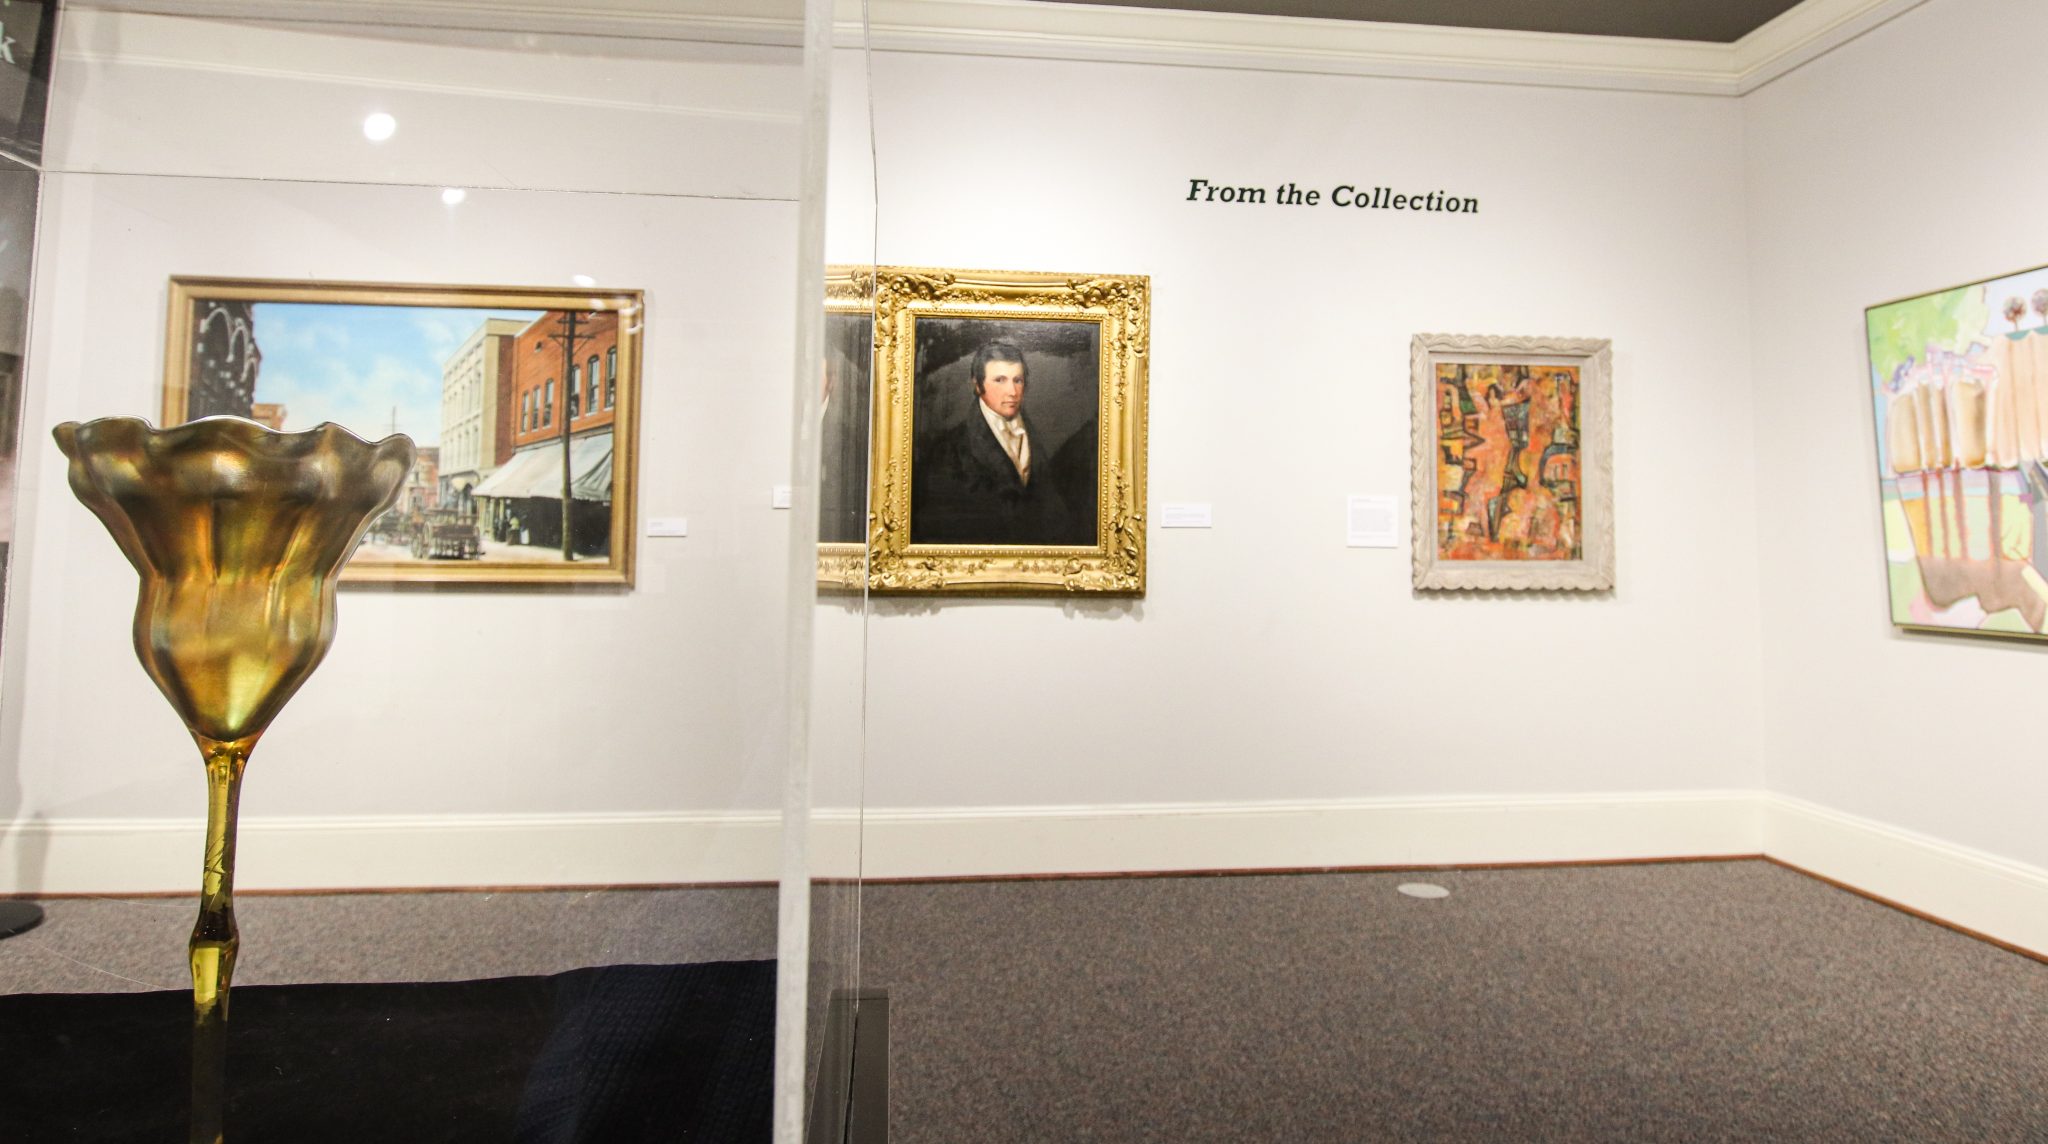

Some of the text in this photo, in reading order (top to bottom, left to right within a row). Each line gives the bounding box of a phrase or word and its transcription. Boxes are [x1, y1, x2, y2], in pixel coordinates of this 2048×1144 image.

[1186, 179, 1479, 214] From the Collection
